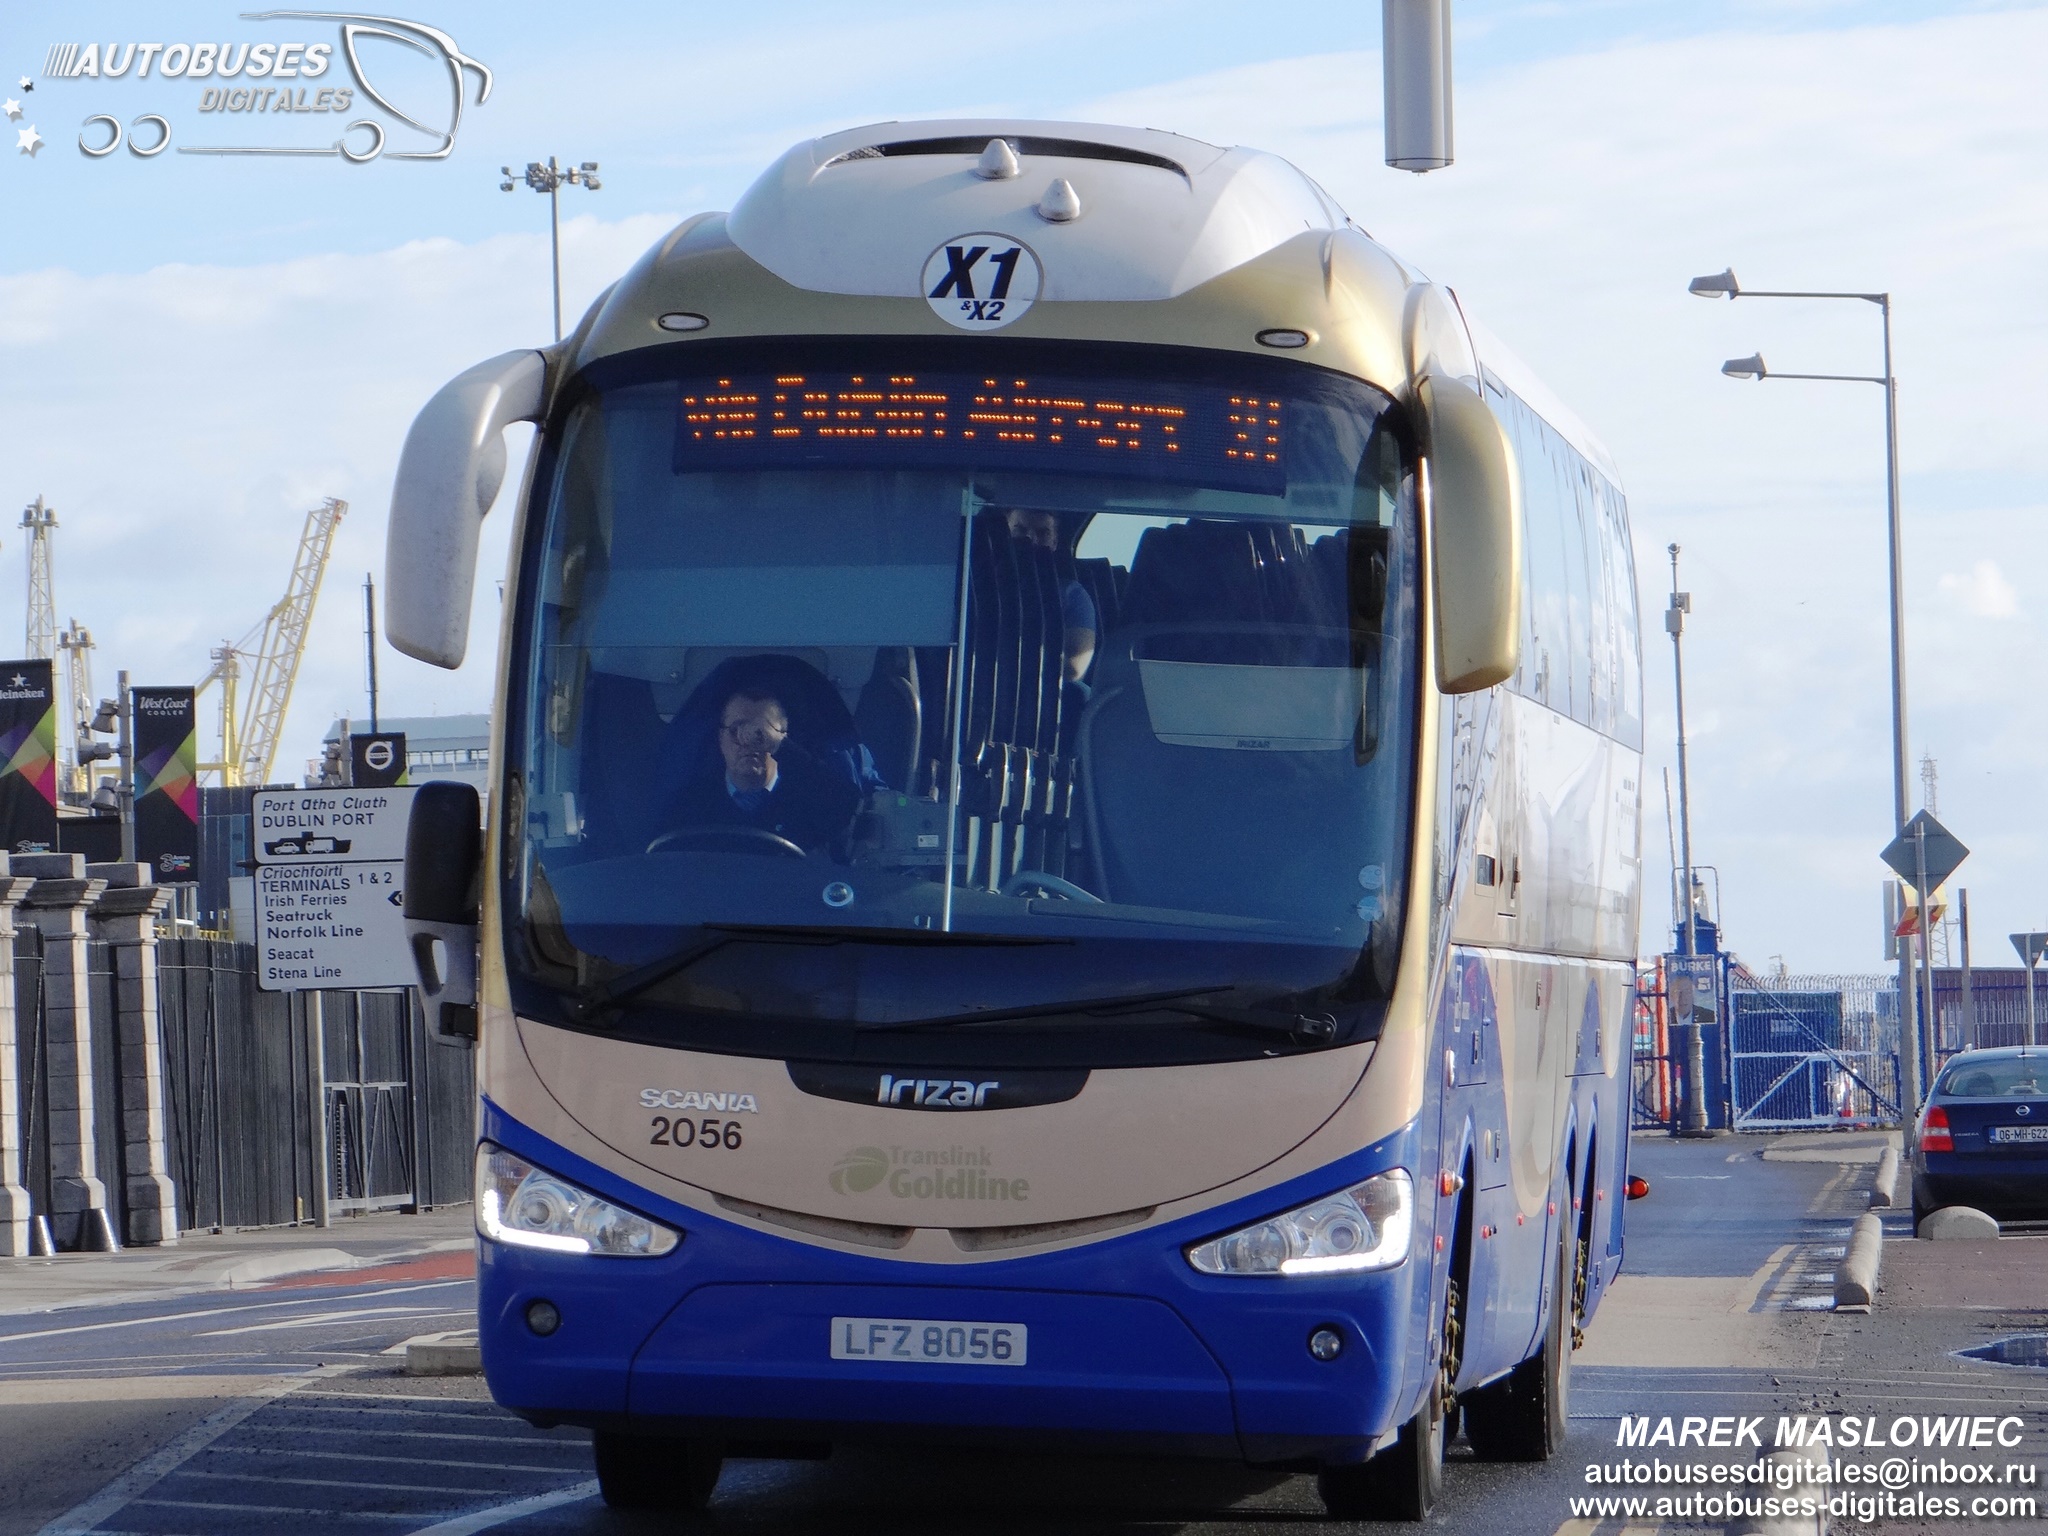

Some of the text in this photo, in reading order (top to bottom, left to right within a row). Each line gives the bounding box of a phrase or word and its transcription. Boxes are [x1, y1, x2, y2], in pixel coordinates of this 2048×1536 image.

[928, 246, 1022, 299] X1
[139, 696, 189, 710] West Coast
[262, 799, 296, 812] Port
[262, 812, 375, 828] DUBLIN PORT
[260, 872, 392, 892] TERMINALS 1 & 2
[264, 894, 348, 907] Irish Ferries
[266, 909, 333, 922] Seatruck
[267, 924, 364, 939] Norfolk Line
[267, 948, 314, 960] Seacat
[268, 966, 342, 979] Stena Line
[1670, 961, 1712, 972] BURKE
[639, 1088, 759, 1114] SCANIA
[650, 1116, 743, 1150] 2056
[889, 1145, 992, 1166] Translink
[889, 1168, 1030, 1201] Goldline
[845, 1323, 1013, 1360] LFZ 8056
